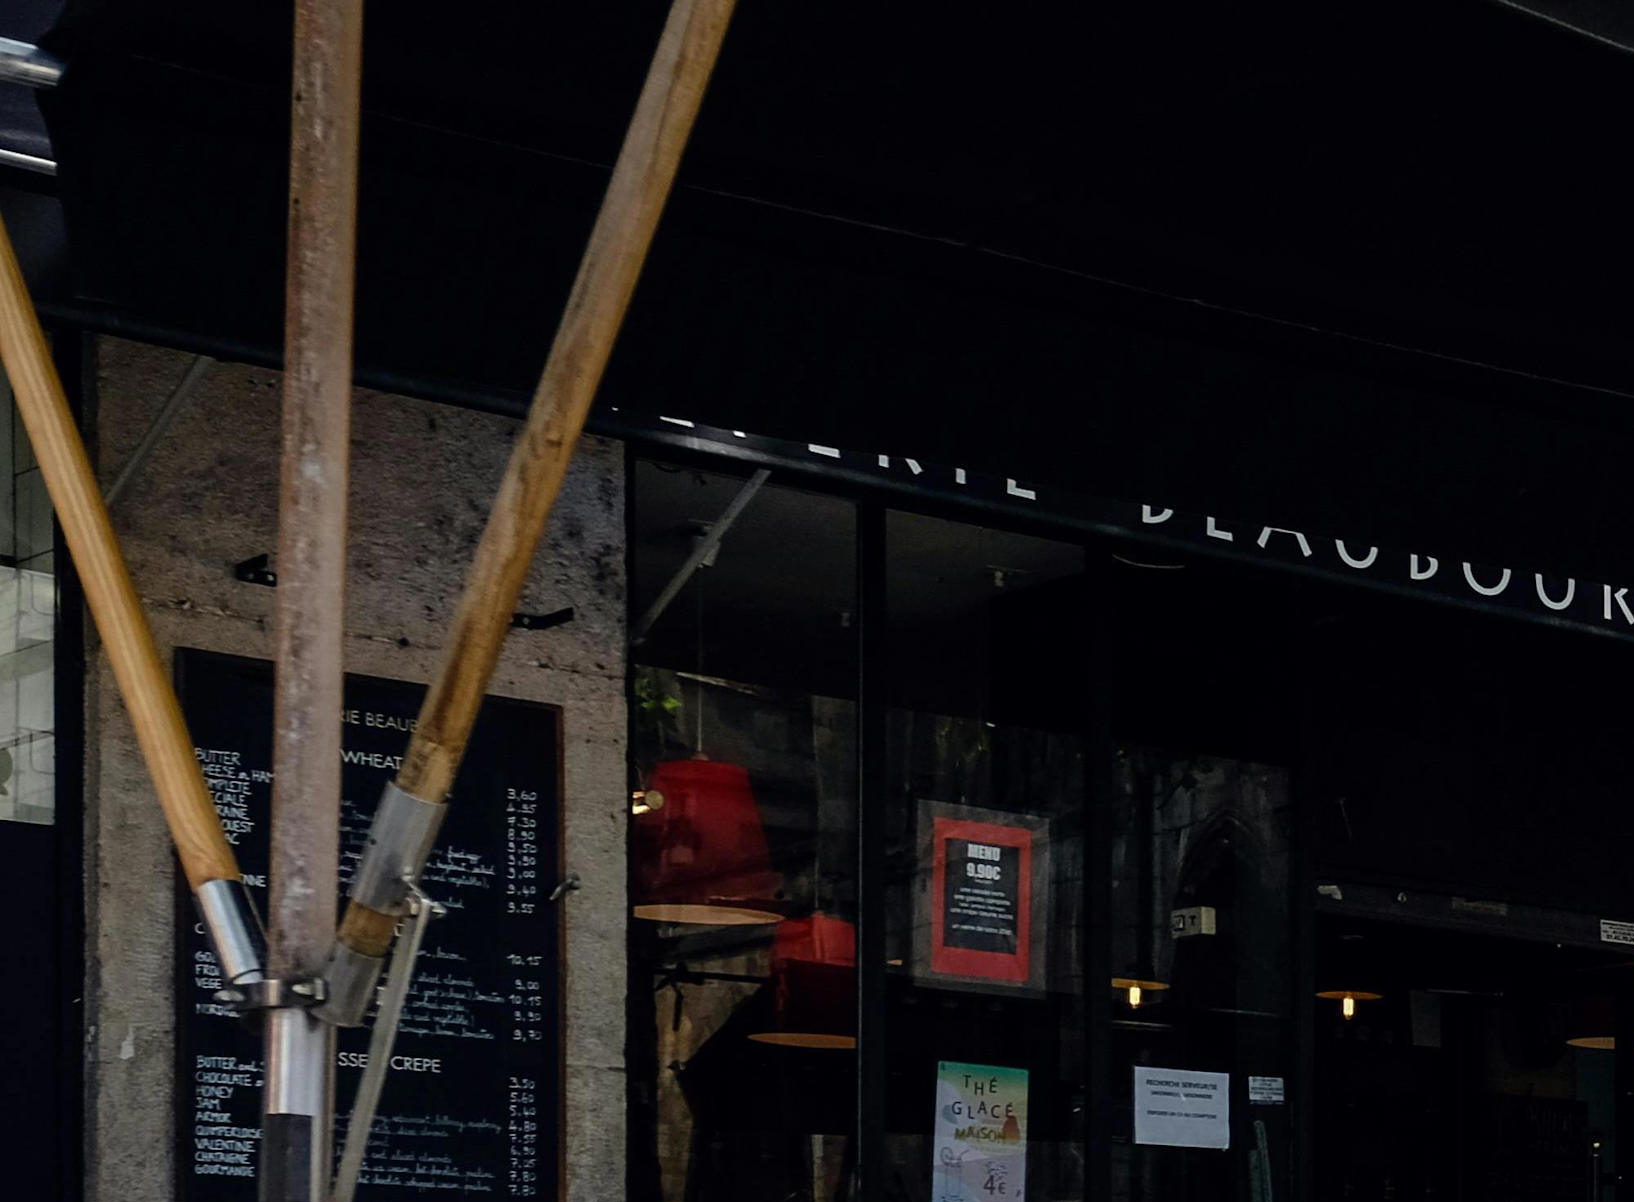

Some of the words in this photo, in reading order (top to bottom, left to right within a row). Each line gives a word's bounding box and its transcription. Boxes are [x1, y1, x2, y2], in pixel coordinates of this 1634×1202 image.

[202, 763, 237, 779] HEESE
[195, 1055, 237, 1071] BUTTER
[390, 1060, 444, 1076] CREPE
[195, 1085, 235, 1099] HONEY
[963, 1074, 999, 1097] THÉ
[952, 1101, 1015, 1120] GLACÉ
[954, 1126, 1006, 1145] MAISON
